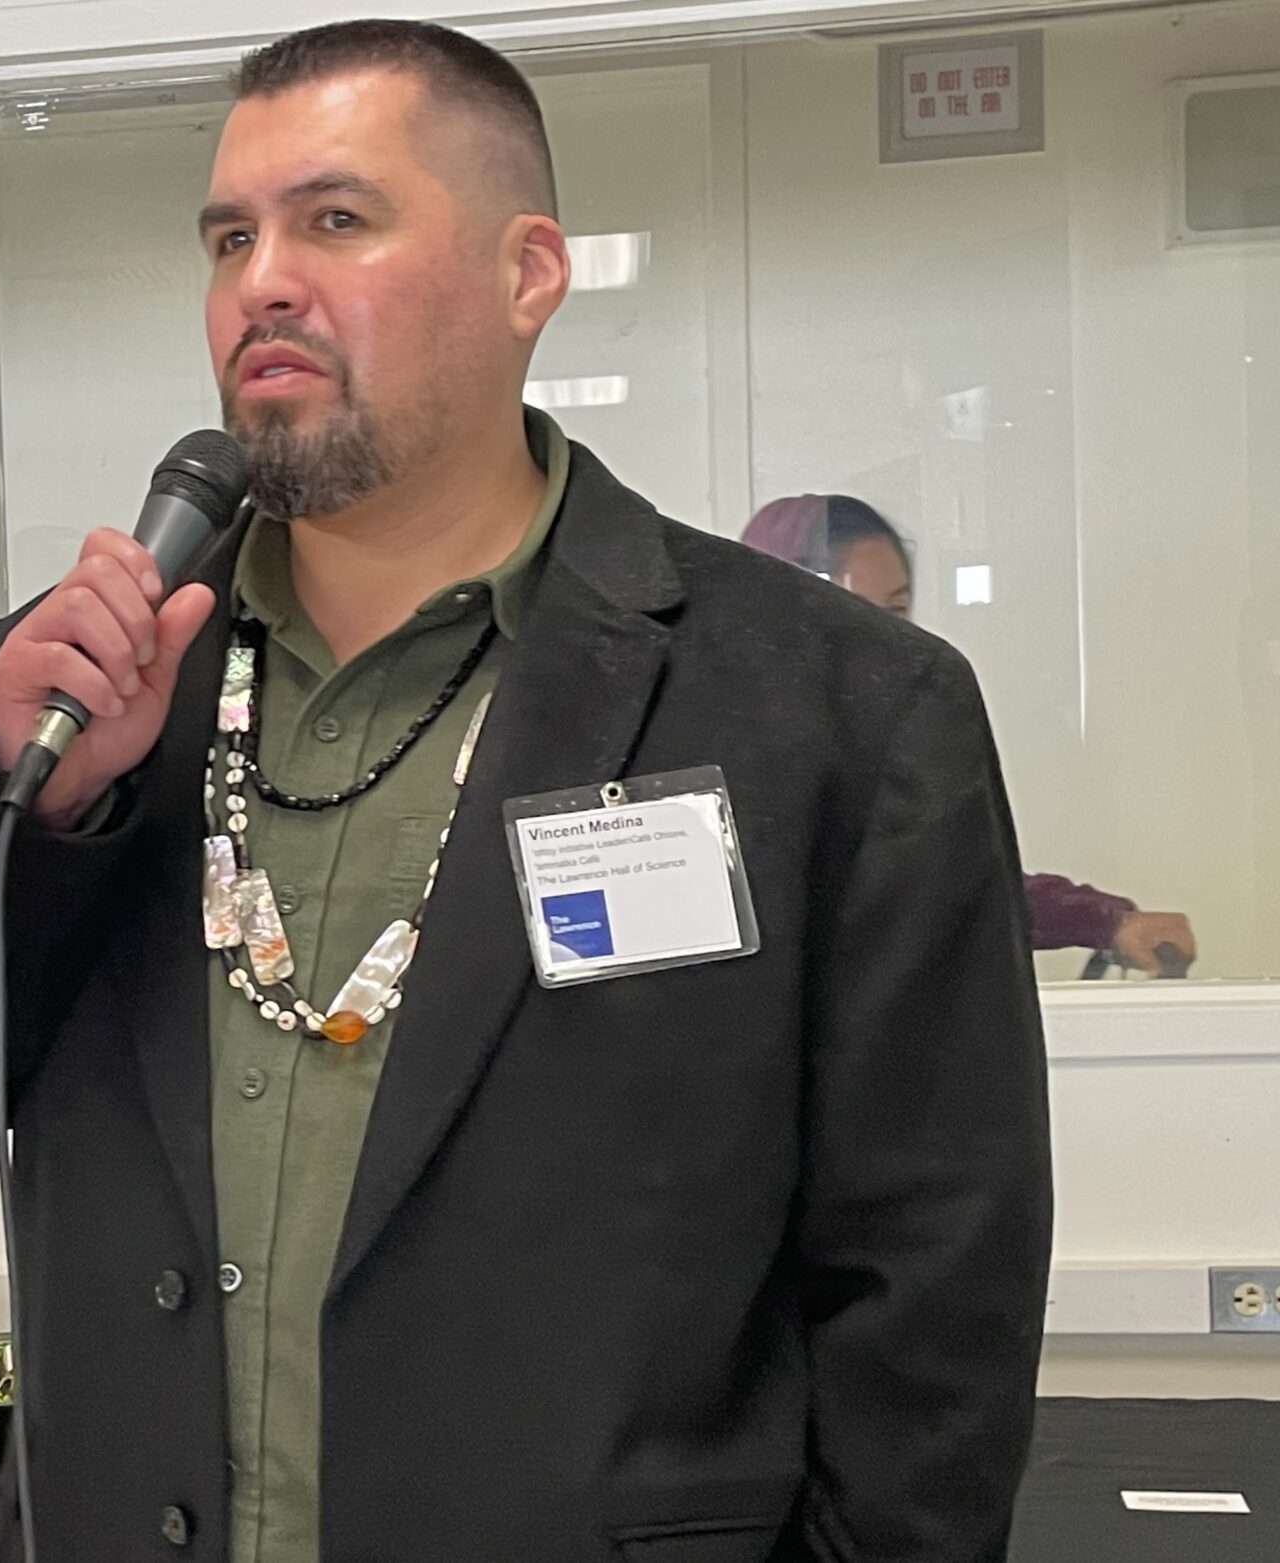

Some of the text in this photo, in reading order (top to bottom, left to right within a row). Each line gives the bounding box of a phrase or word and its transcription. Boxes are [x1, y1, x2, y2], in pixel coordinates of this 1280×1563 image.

[938, 69, 963, 92] NOT
[973, 65, 1011, 89] ENTER
[527, 816, 644, 842] Vincent Medina
[537, 858, 686, 886] The Lawrence Hall of Science
